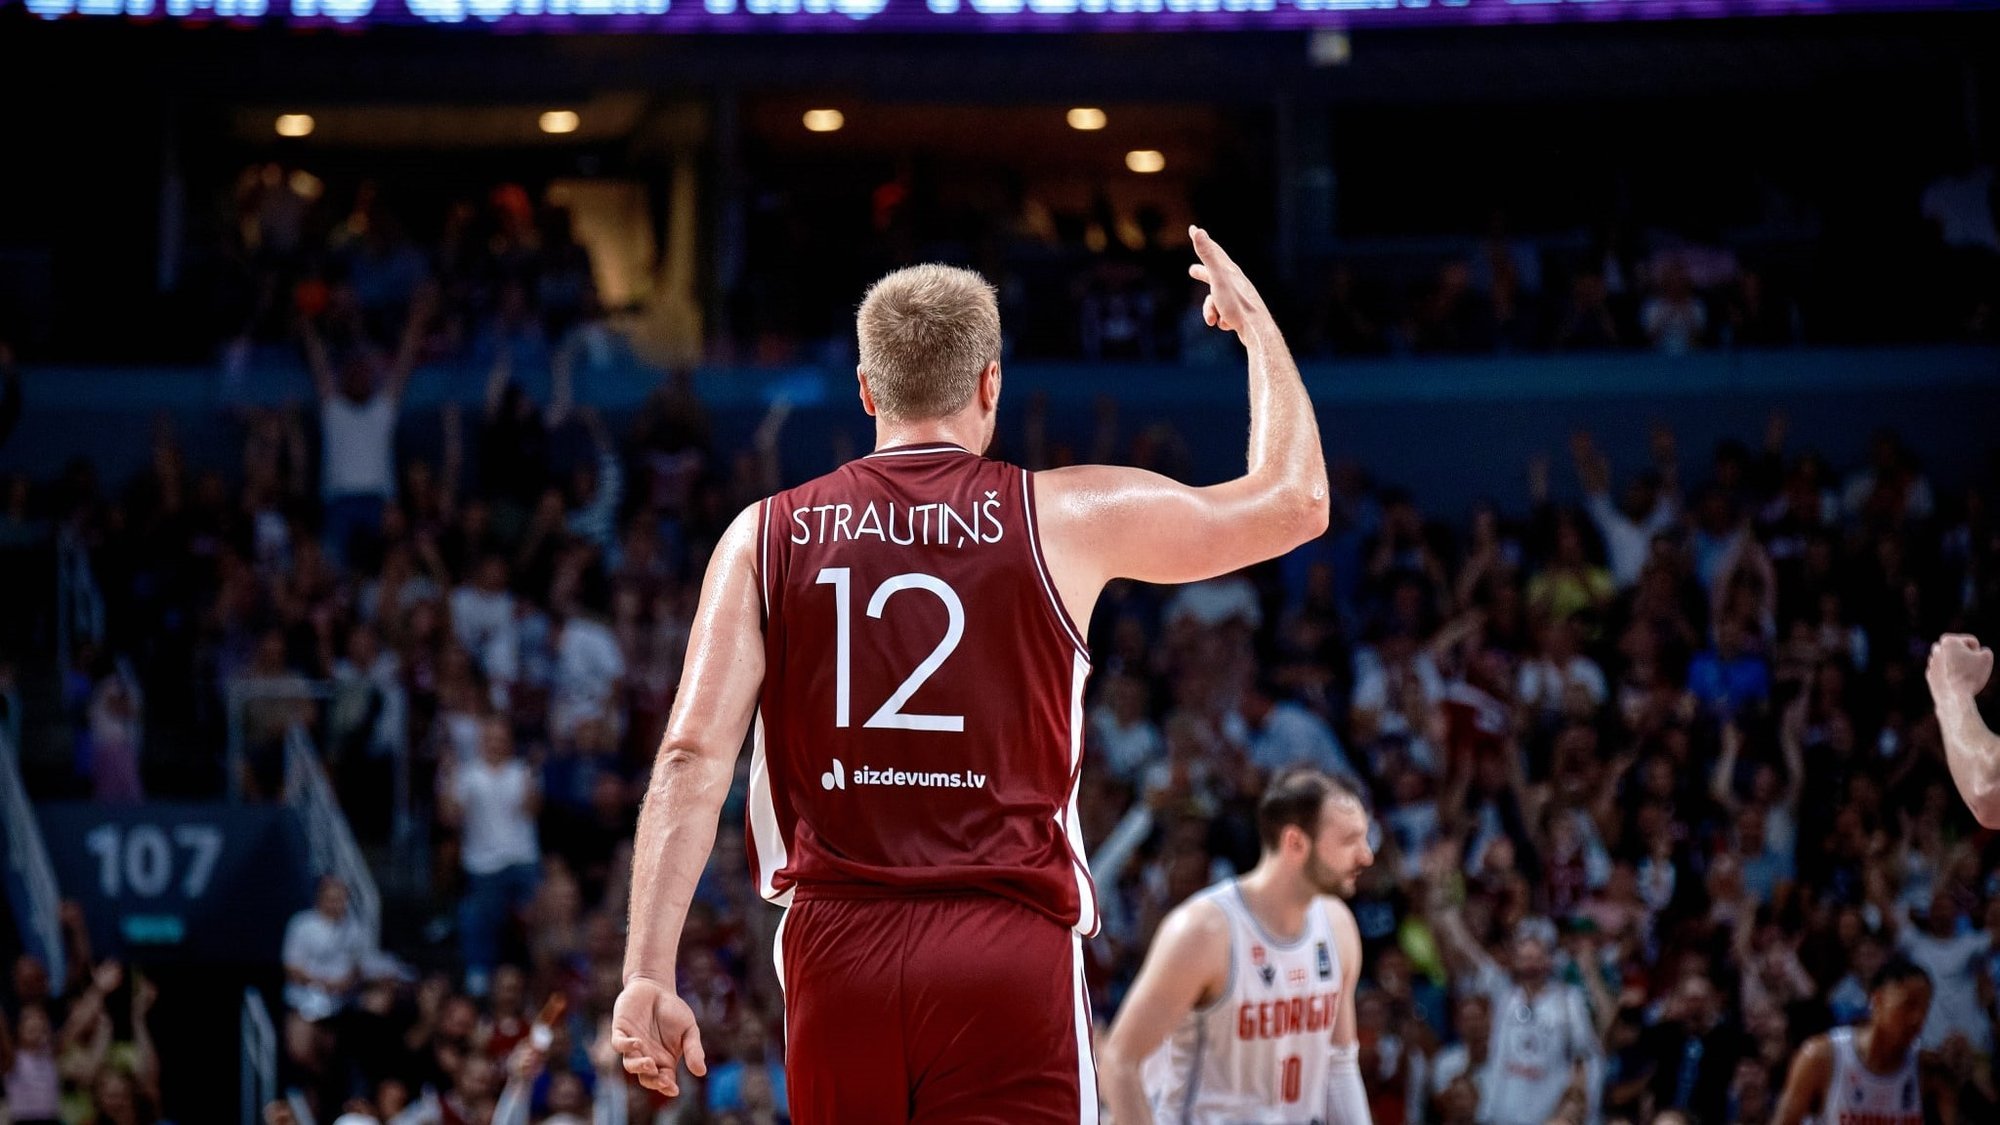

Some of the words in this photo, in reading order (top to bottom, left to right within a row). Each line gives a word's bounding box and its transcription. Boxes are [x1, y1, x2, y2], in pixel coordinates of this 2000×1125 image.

[791, 490, 1004, 549] STRAUTIŅŠ
[815, 567, 965, 732] 12
[853, 765, 987, 789] aizdevums.lv
[87, 824, 222, 897] 107
[1280, 1055, 1302, 1104] 10
